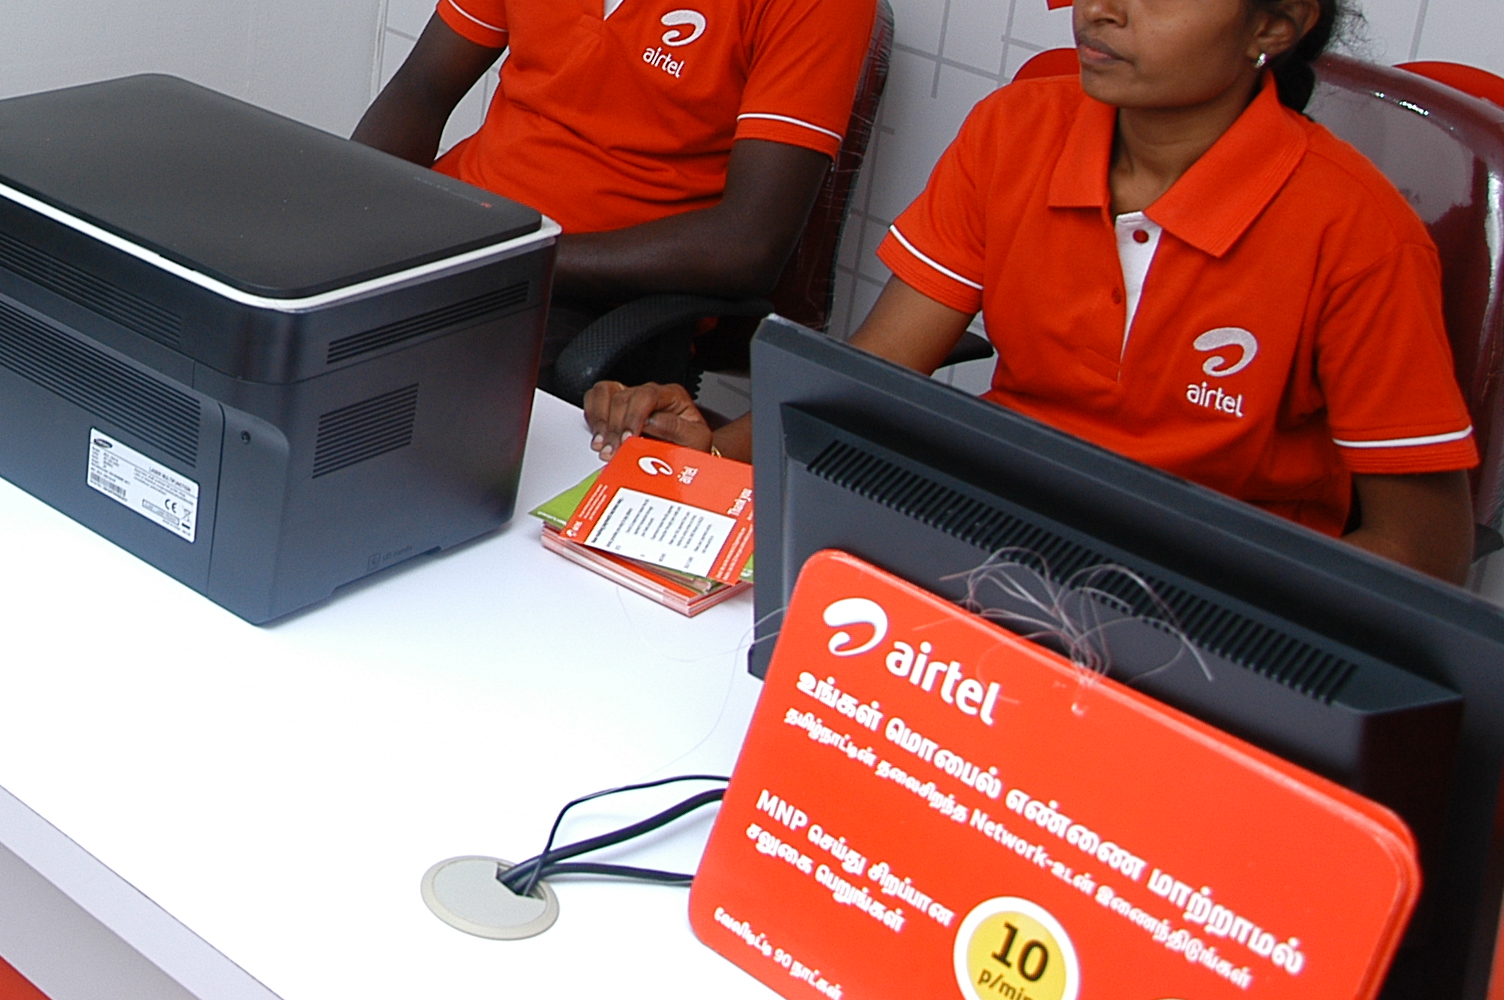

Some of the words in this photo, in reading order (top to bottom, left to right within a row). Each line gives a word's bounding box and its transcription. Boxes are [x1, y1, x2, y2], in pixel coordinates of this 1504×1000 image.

[643, 46, 685, 78] airtel
[1186, 381, 1244, 418] airtel
[886, 640, 1002, 726] airtel
[784, 707, 878, 767] தமிழ்நாட்டின்
[874, 758, 970, 824] தலைசிறந்த
[755, 788, 809, 831] MNP
[807, 824, 867, 876] செய்து
[867, 861, 957, 927] சிறப்பான
[796, 671, 884, 731] உங்கள்
[885, 717, 1003, 799] மொபைல்
[1005, 788, 1148, 881] எண்ணை
[1147, 867, 1307, 977] மாற்றாமல்
[745, 822, 815, 875] சலுகை
[814, 864, 908, 933] பெறுங்கள்
[773, 948, 793, 970] 90
[789, 960, 844, 1000] நாட்கள்
[990, 922, 1050, 983] 10
